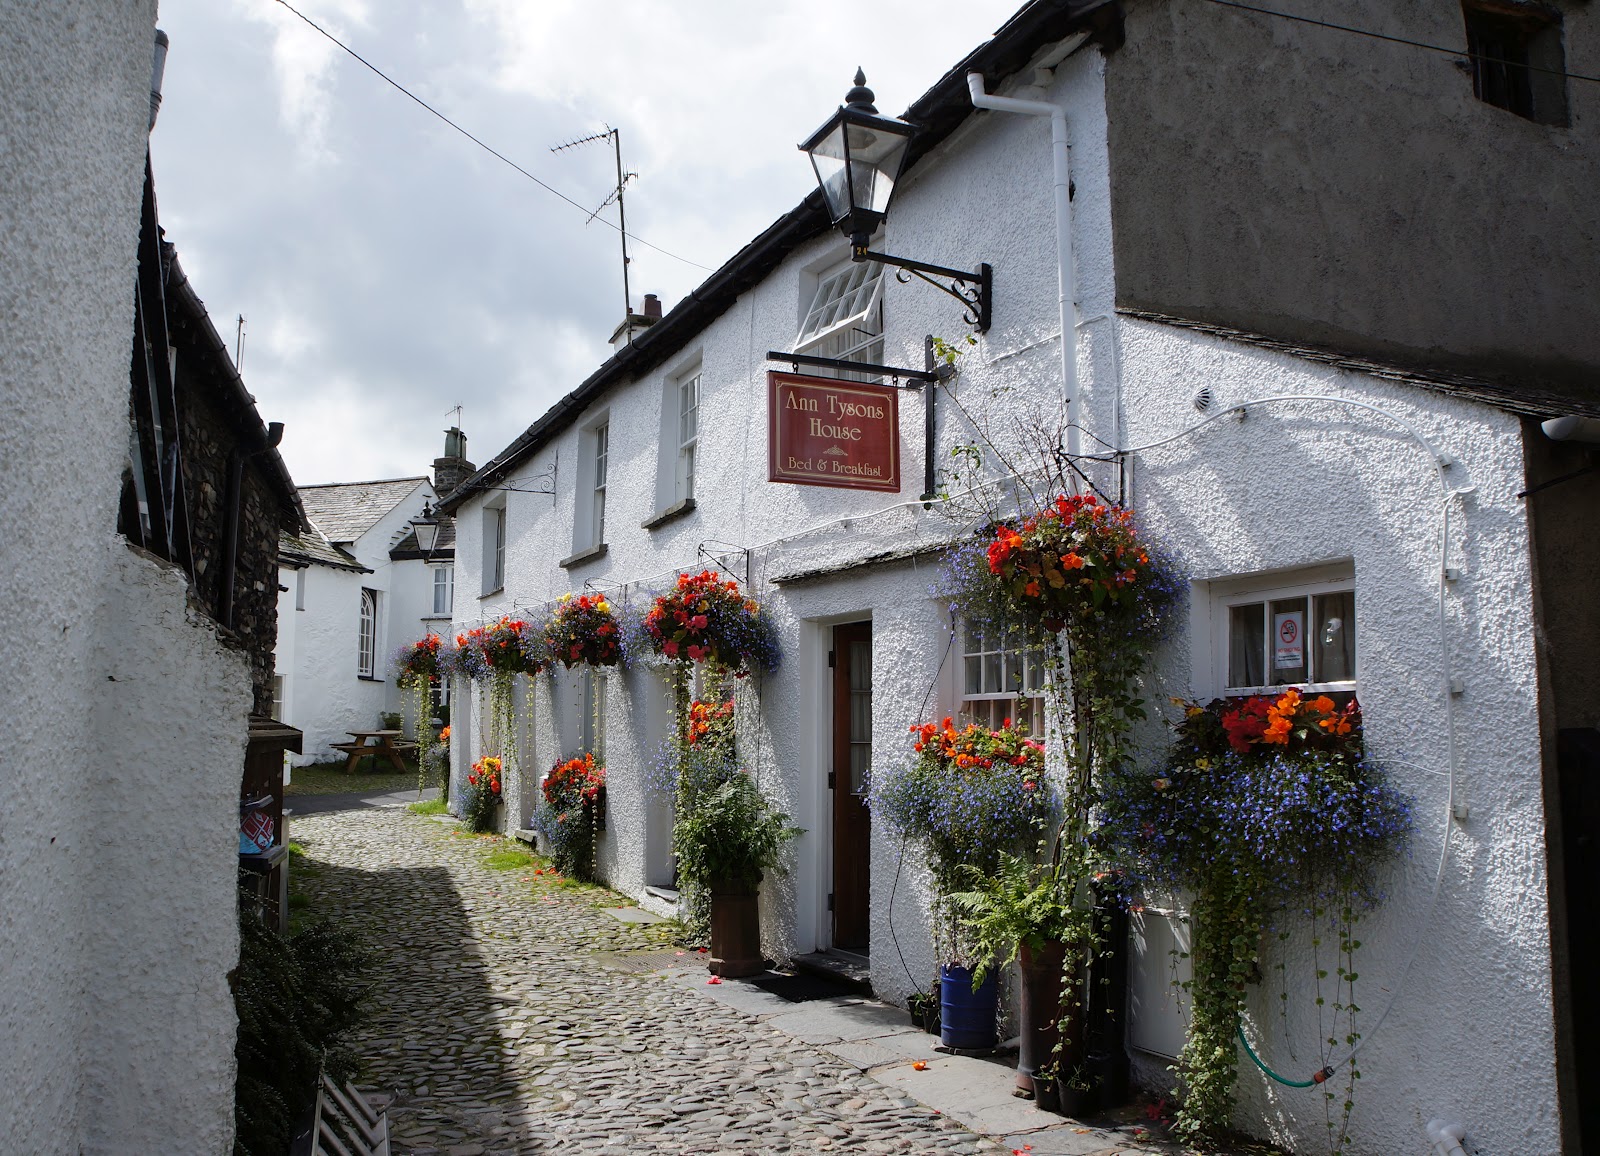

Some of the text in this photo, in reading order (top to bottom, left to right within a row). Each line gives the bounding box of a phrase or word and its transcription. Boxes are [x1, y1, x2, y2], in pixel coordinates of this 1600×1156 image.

[785, 390, 884, 421] Ann Tysons
[809, 417, 862, 441] House
[788, 456, 882, 477] Bed & Breakfast
